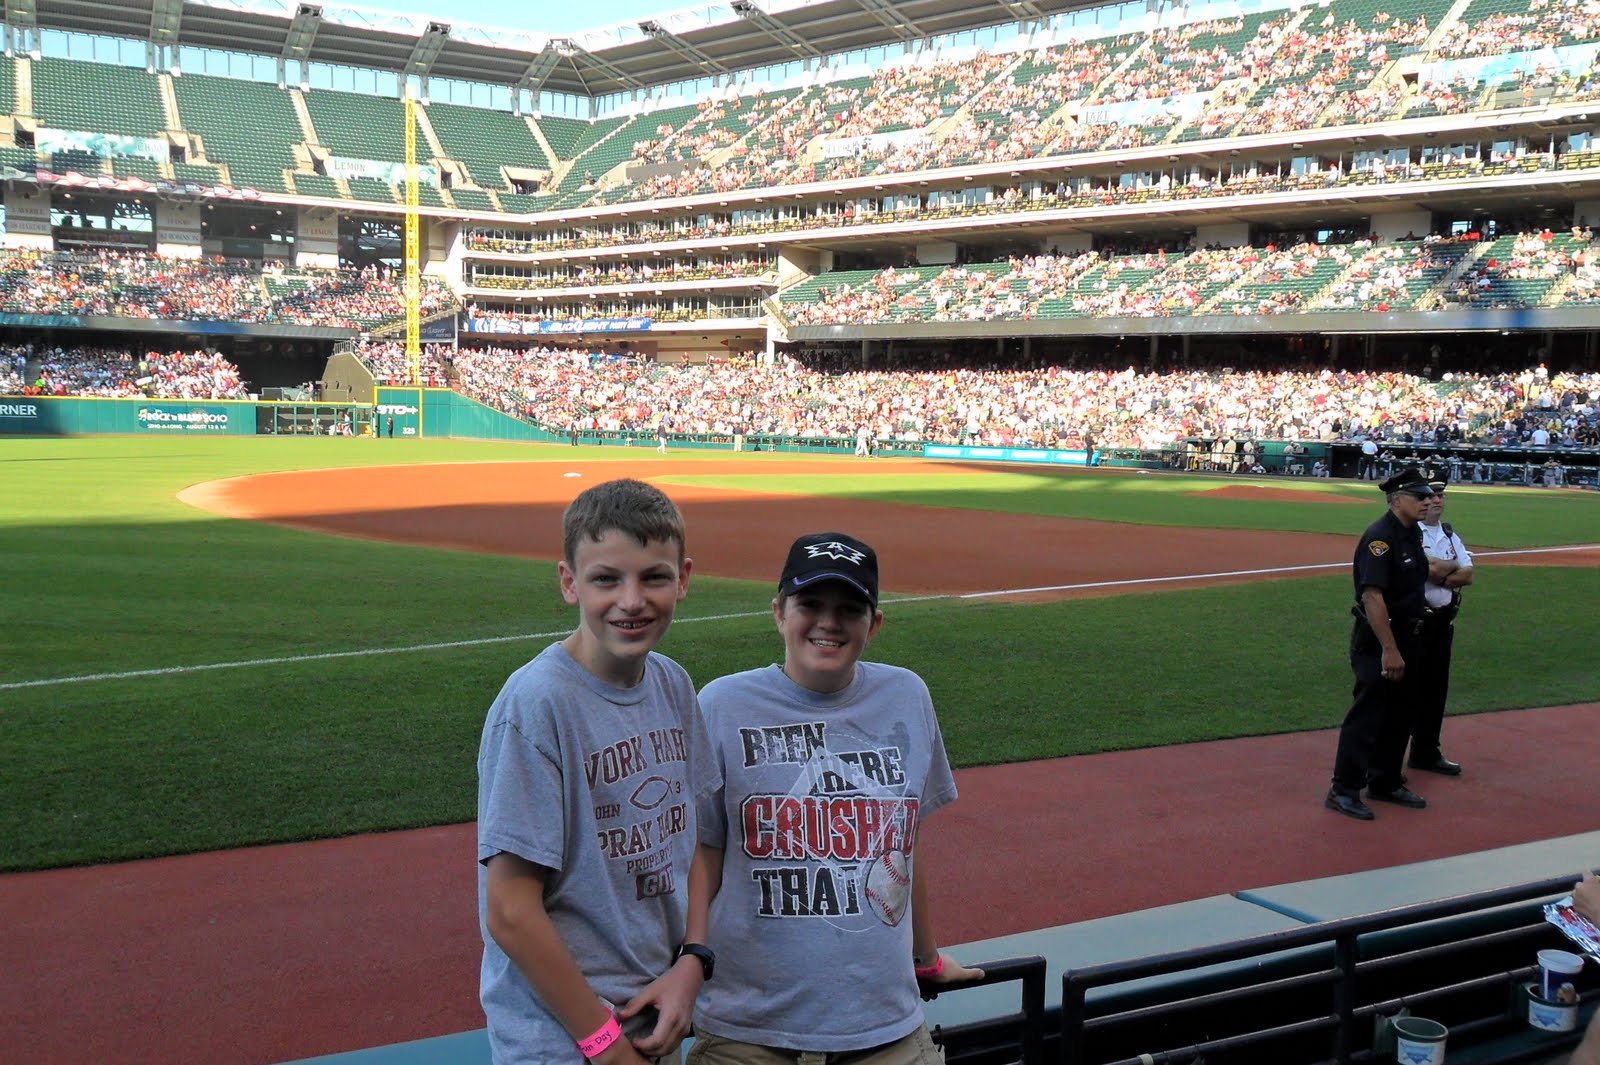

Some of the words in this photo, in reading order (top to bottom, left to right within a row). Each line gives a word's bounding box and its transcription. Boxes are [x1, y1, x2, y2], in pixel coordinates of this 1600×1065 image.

[334, 159, 365, 172] LEMON
[0, 404, 38, 416] RNER
[146, 412, 170, 422] ROCK
[204, 412, 228, 424] 2010
[402, 427, 416, 435] 325
[738, 721, 826, 768] BEEN
[742, 793, 921, 863] CRUSHED
[752, 865, 864, 918] THAT
[595, 1030, 612, 1044] Day
